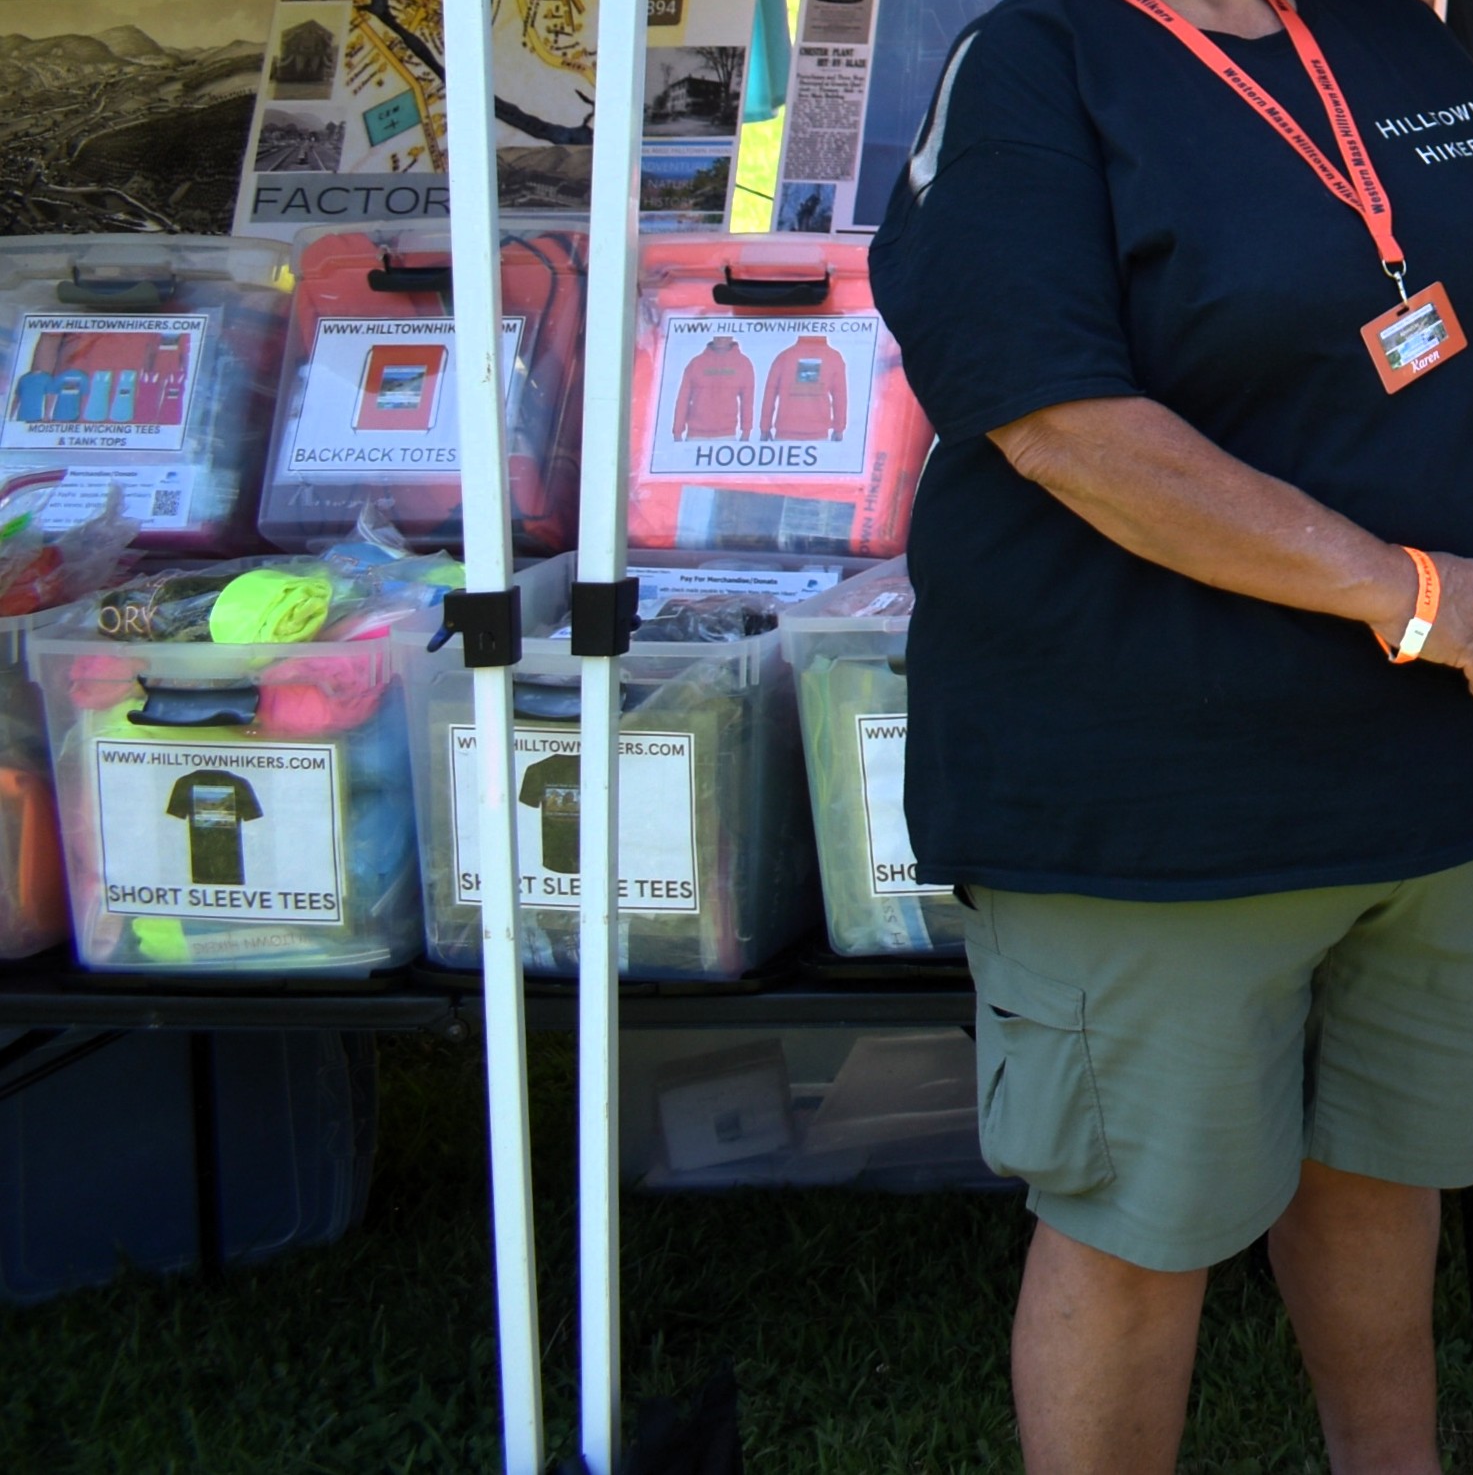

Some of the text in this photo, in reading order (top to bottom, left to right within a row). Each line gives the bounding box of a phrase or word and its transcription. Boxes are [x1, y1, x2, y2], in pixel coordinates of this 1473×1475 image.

[1223, 67, 1335, 180] Western Mass Hilltown
[1311, 59, 1385, 214] Western Mass Hilltown Hikers
[28, 319, 201, 330] WWW.HILLTOWNHIKERS.COM
[673, 321, 873, 333] WWW.HILLTOWNHIKERS.COM
[1411, 350, 1440, 373] Karen
[28, 424, 160, 434] MOISTURE WICKING TEES
[58, 437, 127, 446] & TANK TOPS
[294, 448, 456, 462] BACKPACK TOTES
[695, 445, 818, 467] HOODIES
[863, 452, 887, 512] HIKERS
[102, 750, 326, 770] WWW.HILLTOWNHIKERS.COM
[109, 884, 336, 910] SHORT SLEEVE TEES
[635, 880, 692, 899] TEES
